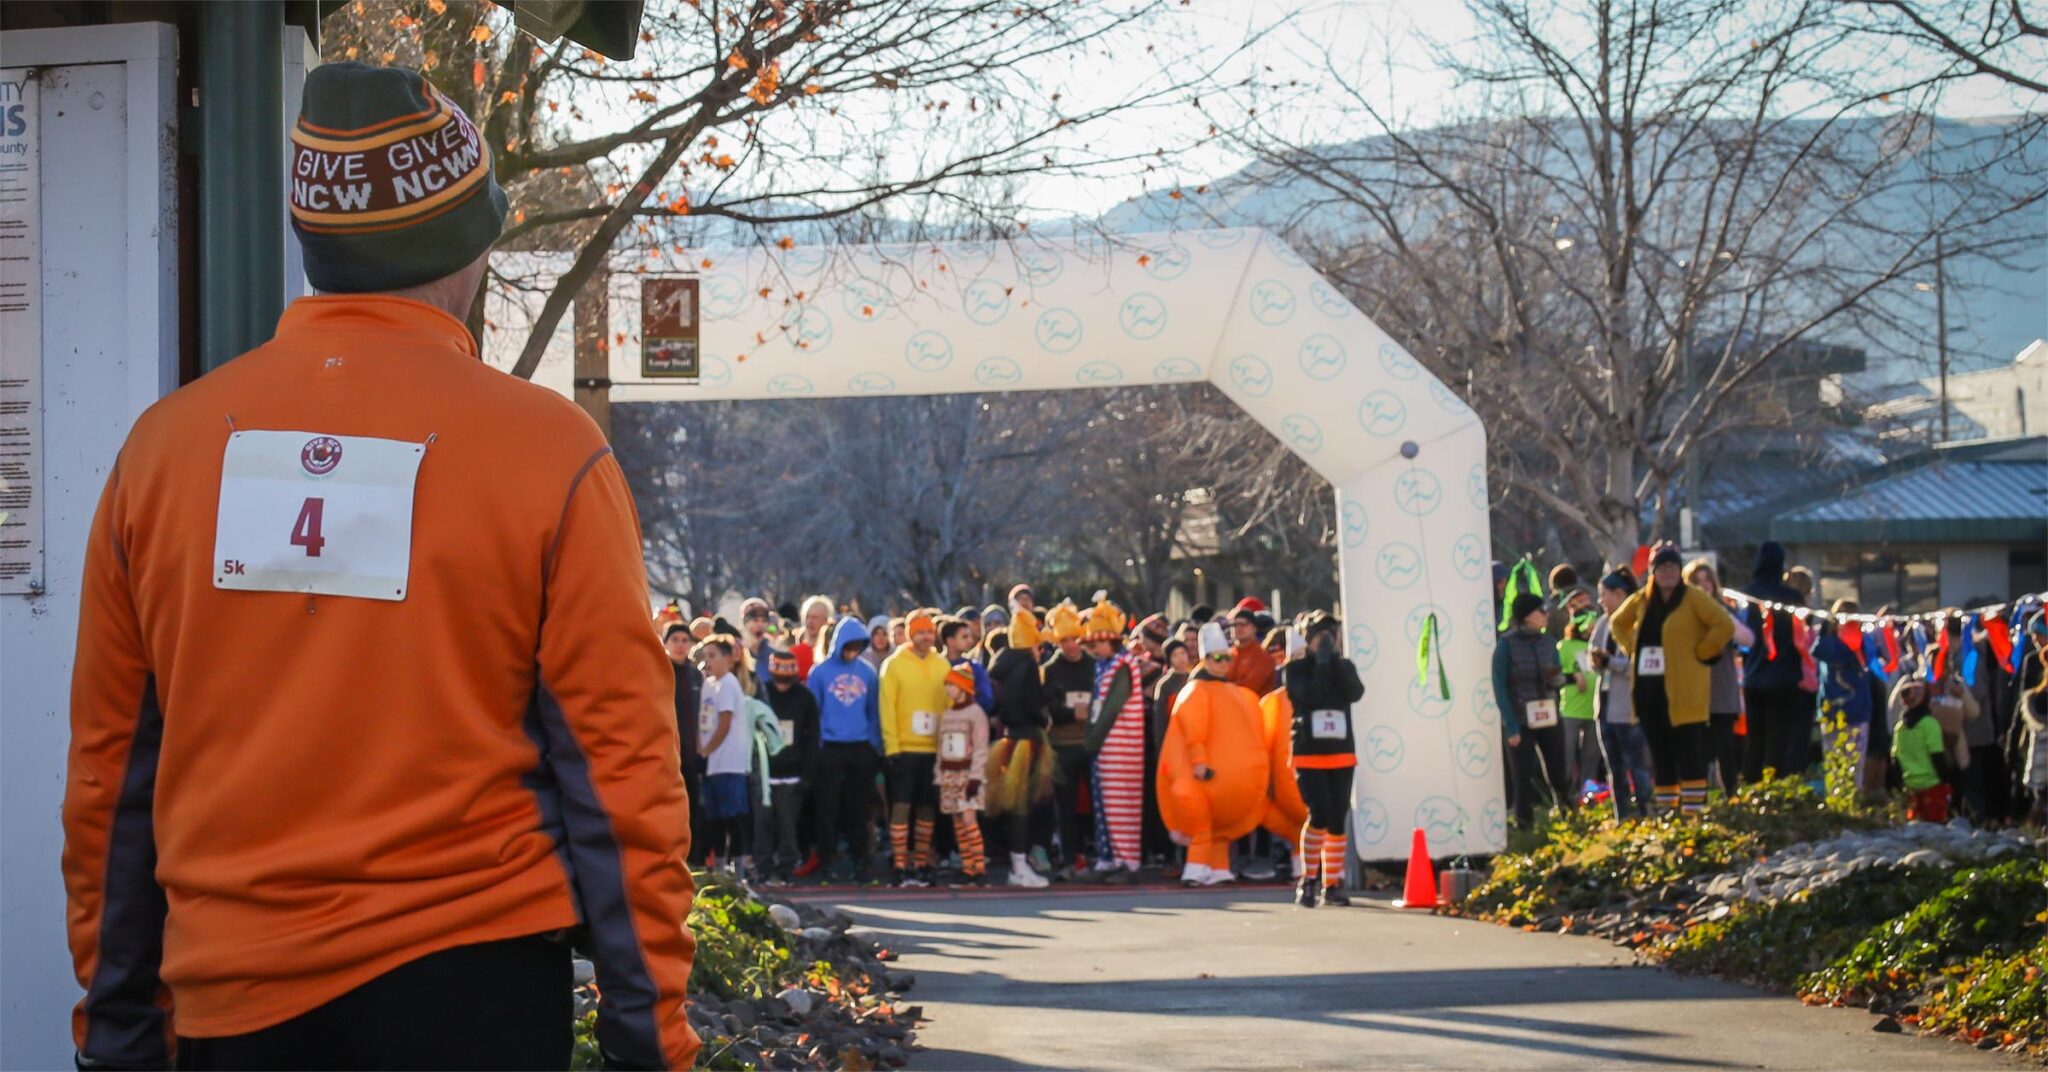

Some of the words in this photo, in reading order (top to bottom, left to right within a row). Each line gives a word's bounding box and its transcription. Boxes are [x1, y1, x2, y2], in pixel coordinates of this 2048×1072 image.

[294, 177, 372, 210] NCW
[392, 145, 476, 203] NCW
[297, 150, 367, 180] GIVE
[388, 121, 462, 170] GIVE
[290, 497, 325, 557] 4
[223, 560, 245, 575] 5k
